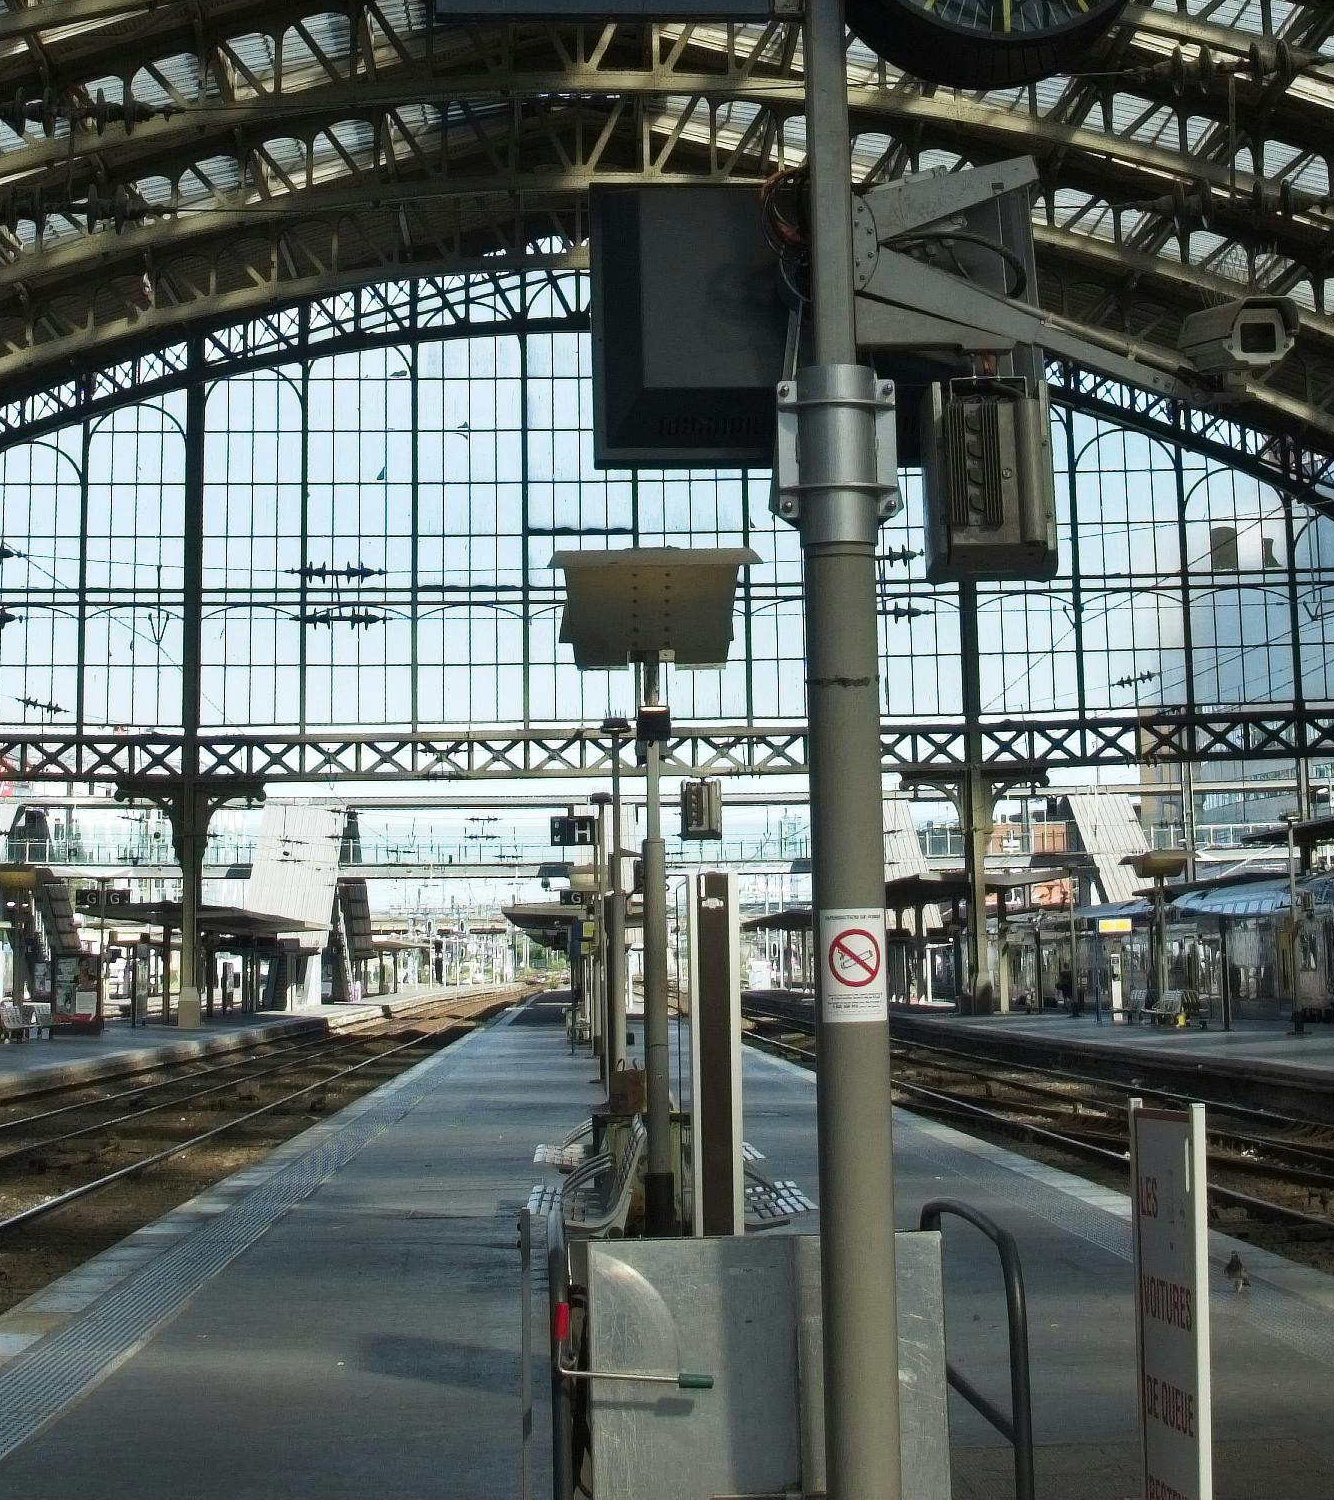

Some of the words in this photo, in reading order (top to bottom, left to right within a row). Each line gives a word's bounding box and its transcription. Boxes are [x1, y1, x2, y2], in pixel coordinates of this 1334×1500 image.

[574, 821, 591, 843] H
[87, 892, 97, 904] G
[110, 892, 120, 904] G
[571, 891, 581, 904] G
[1139, 1176, 1158, 1219] LES
[1142, 1276, 1192, 1332] VOITURES
[1146, 1374, 1159, 1420] DE
[1161, 1381, 1194, 1438] QUEUE
